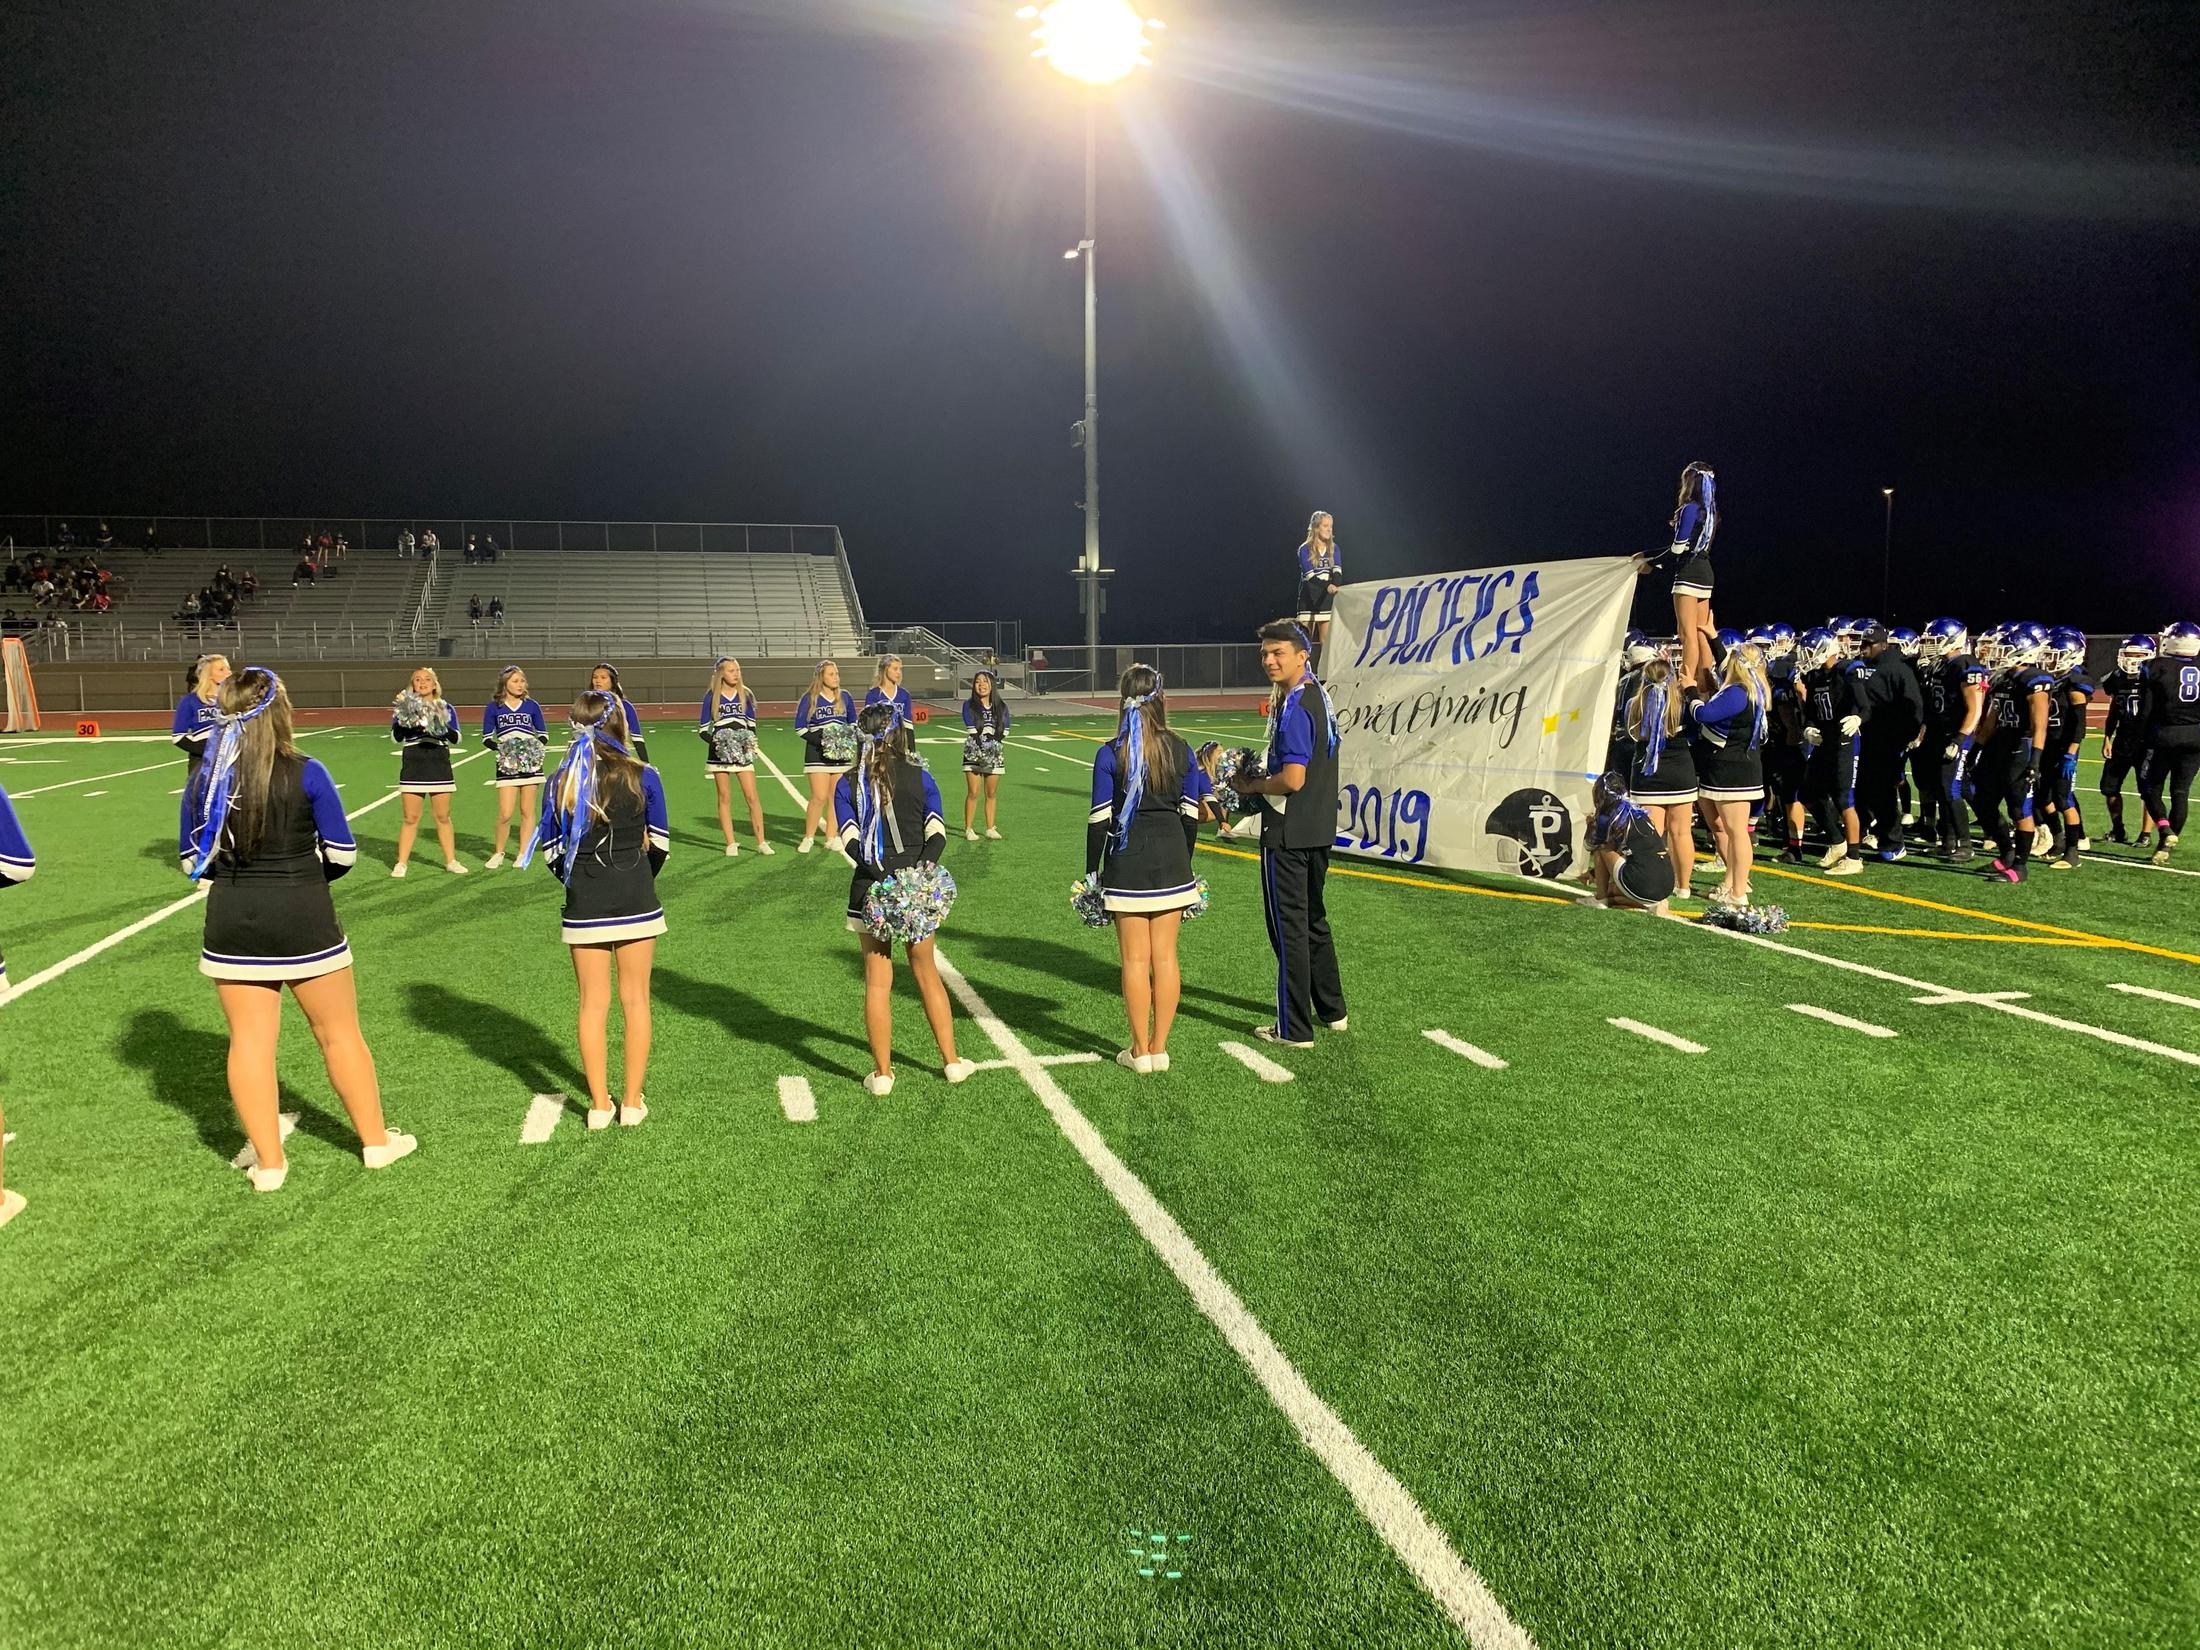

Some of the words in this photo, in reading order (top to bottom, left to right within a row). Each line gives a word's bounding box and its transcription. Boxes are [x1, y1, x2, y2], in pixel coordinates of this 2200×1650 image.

[1354, 570, 1540, 668] PACIFICA
[78, 724, 95, 736] 30
[915, 711, 927, 722] 10
[1334, 783, 1431, 864] 2019
